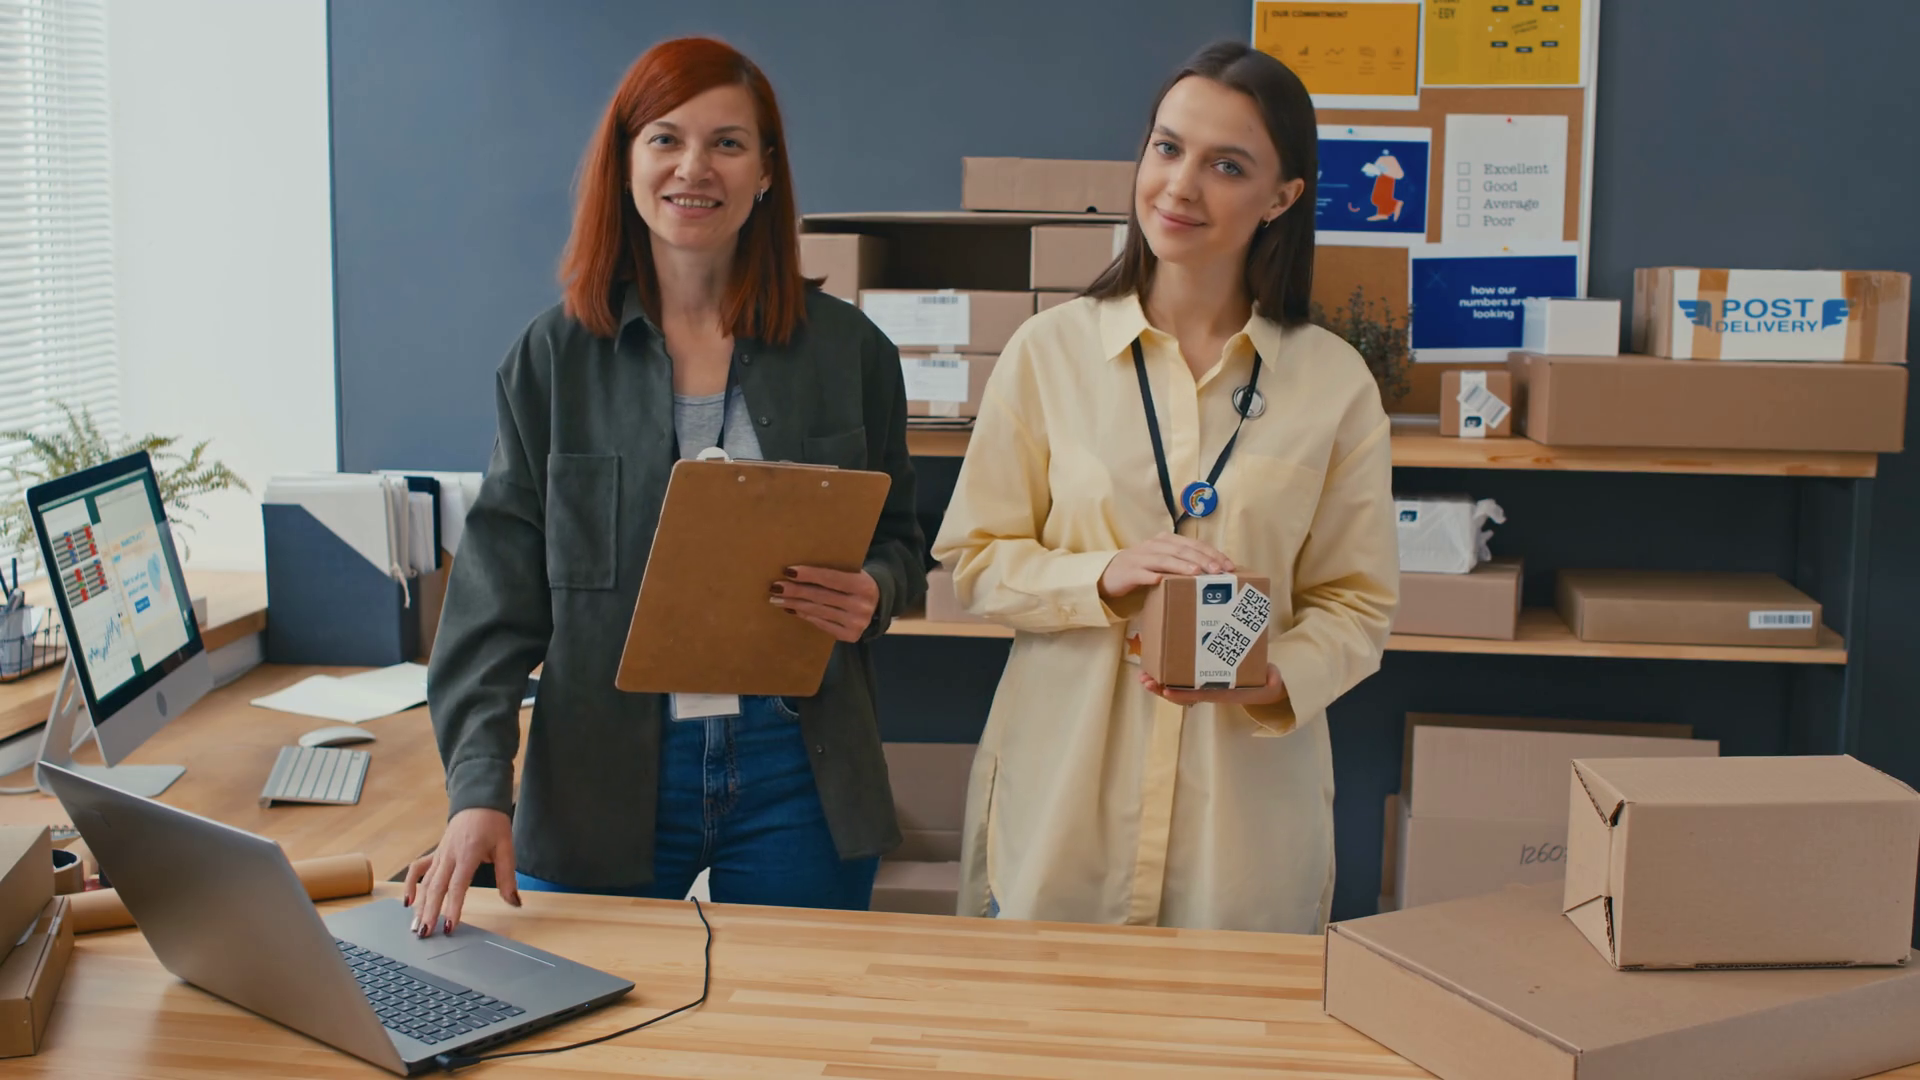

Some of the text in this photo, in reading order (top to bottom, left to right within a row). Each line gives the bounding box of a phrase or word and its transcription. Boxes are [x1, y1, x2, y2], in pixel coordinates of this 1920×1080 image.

[1292, 10, 1348, 18] COMMITMENT
[1484, 163, 1549, 175] Excellent
[1484, 180, 1518, 192] Good
[1483, 198, 1540, 212] Average
[1483, 215, 1515, 227] Poor
[1471, 285, 1517, 295] how our
[1459, 297, 1508, 307] numbers
[1473, 309, 1515, 320] looking
[1722, 298, 1815, 319] POST
[1715, 320, 1818, 333] DELIVERY
[1520, 842, 1567, 865] 1260
